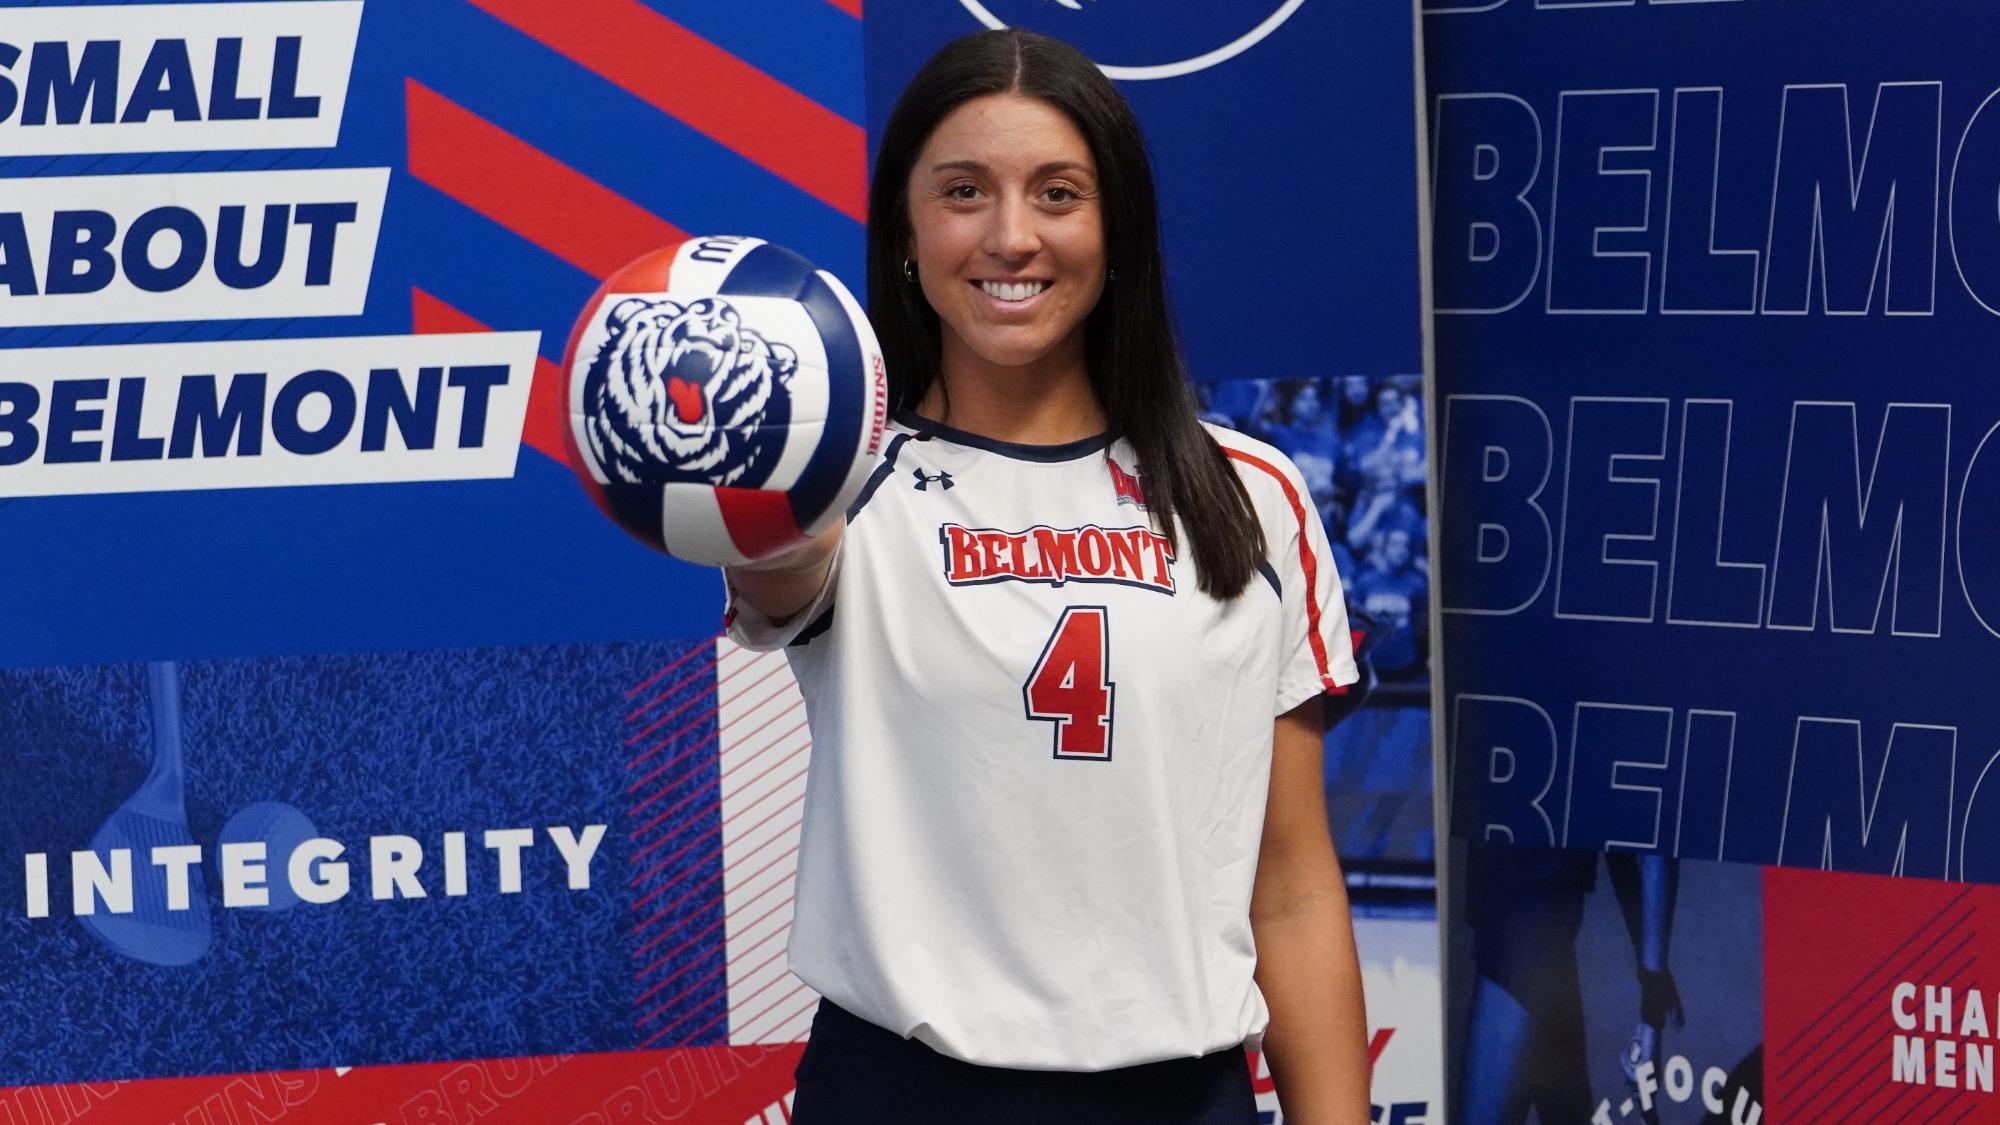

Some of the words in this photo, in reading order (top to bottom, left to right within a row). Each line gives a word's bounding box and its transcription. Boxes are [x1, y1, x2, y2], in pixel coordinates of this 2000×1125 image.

[0, 36, 321, 126] SMALL
[0, 364, 510, 466] BELMONT
[939, 523, 1177, 597] BELMONT
[1022, 605, 1116, 761] 4
[25, 824, 607, 918] INTEGRITY
[1892, 982, 2000, 1039] CHA
[1892, 1035, 1994, 1093] MEN
